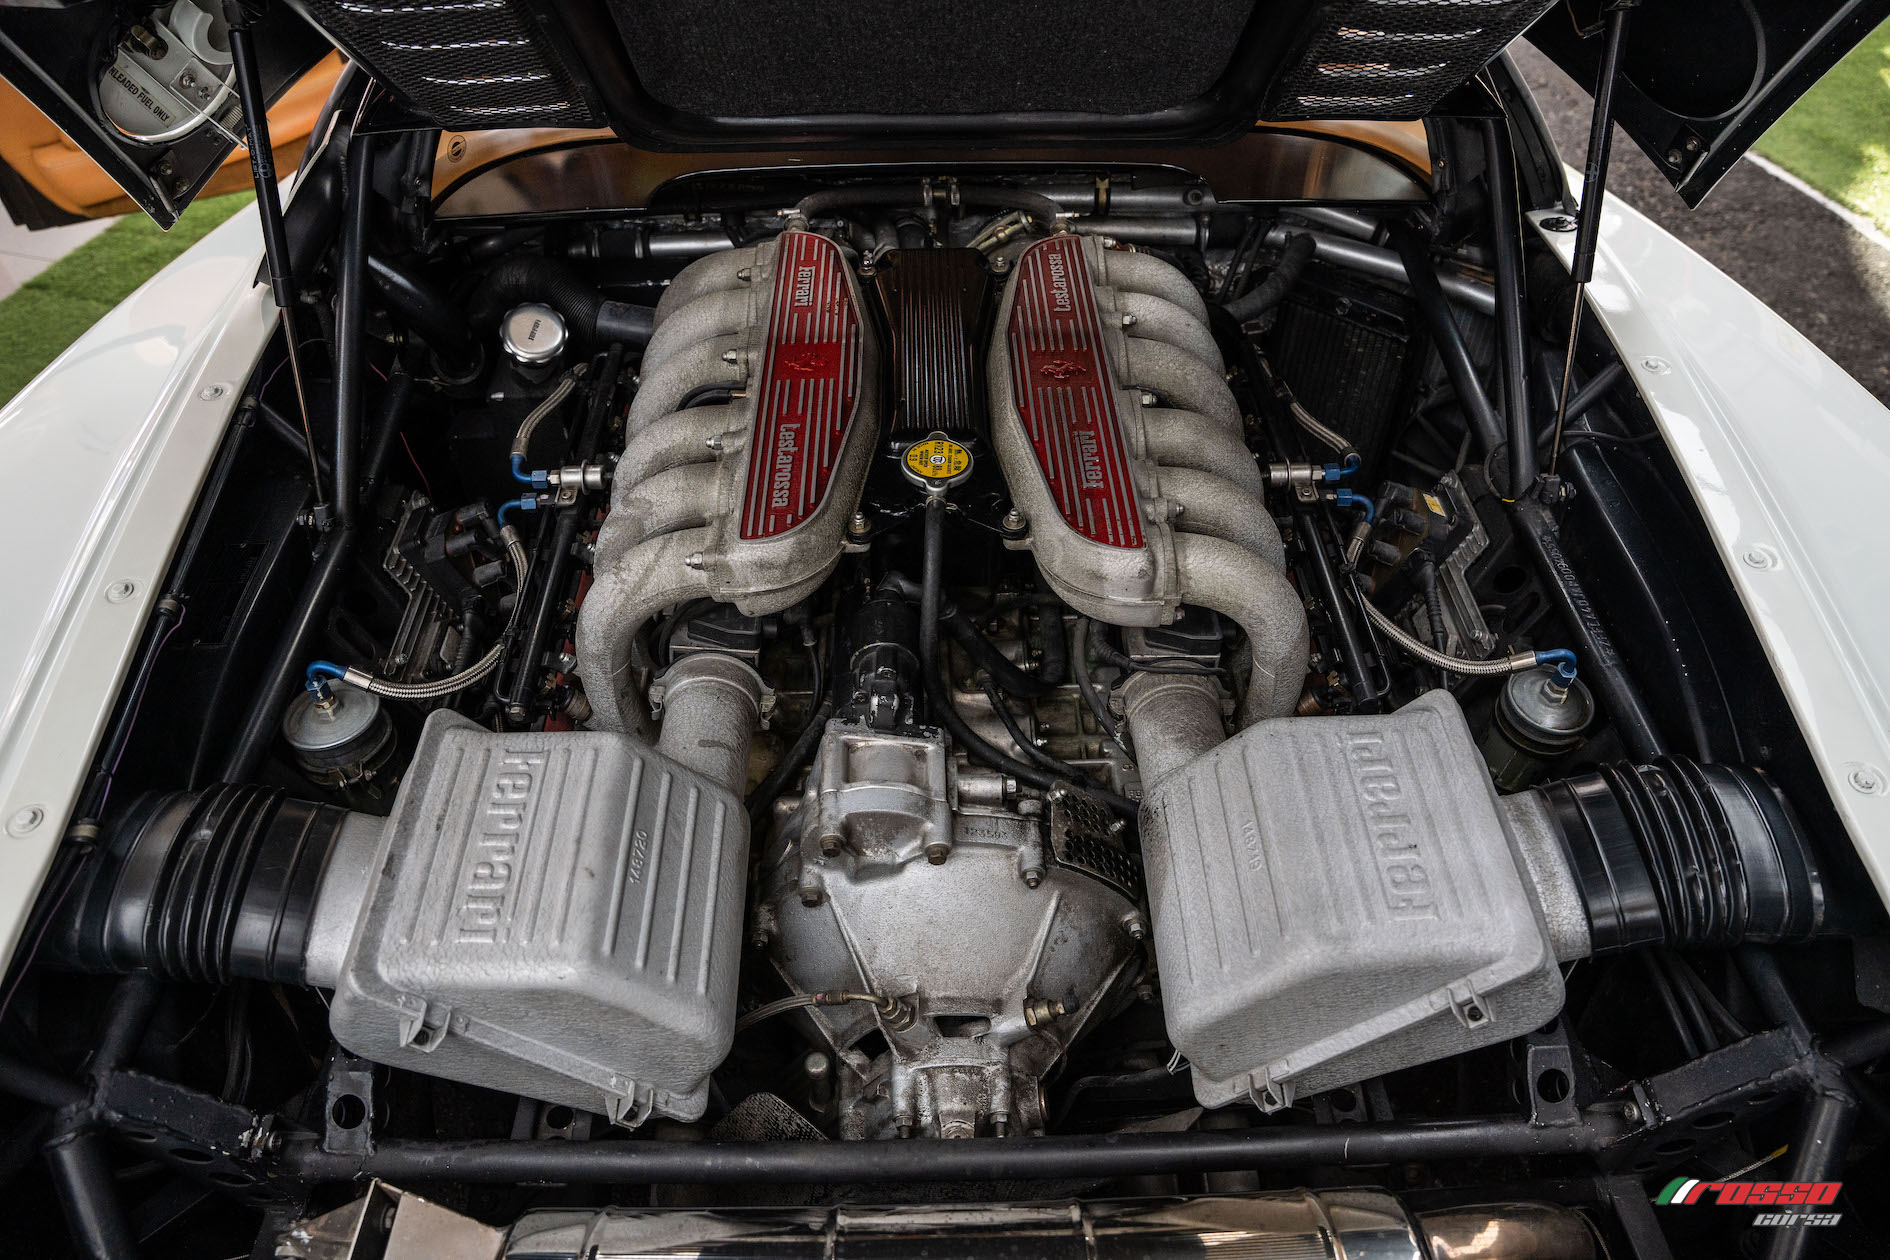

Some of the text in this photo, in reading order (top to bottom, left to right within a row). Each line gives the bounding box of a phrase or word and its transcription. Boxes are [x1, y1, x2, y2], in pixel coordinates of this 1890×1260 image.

[108, 66, 171, 122] NLEADED FUEL ONLY
[795, 266, 816, 307] Ferrari
[1072, 430, 1104, 489] Ferrari
[628, 829, 648, 885] 148720
